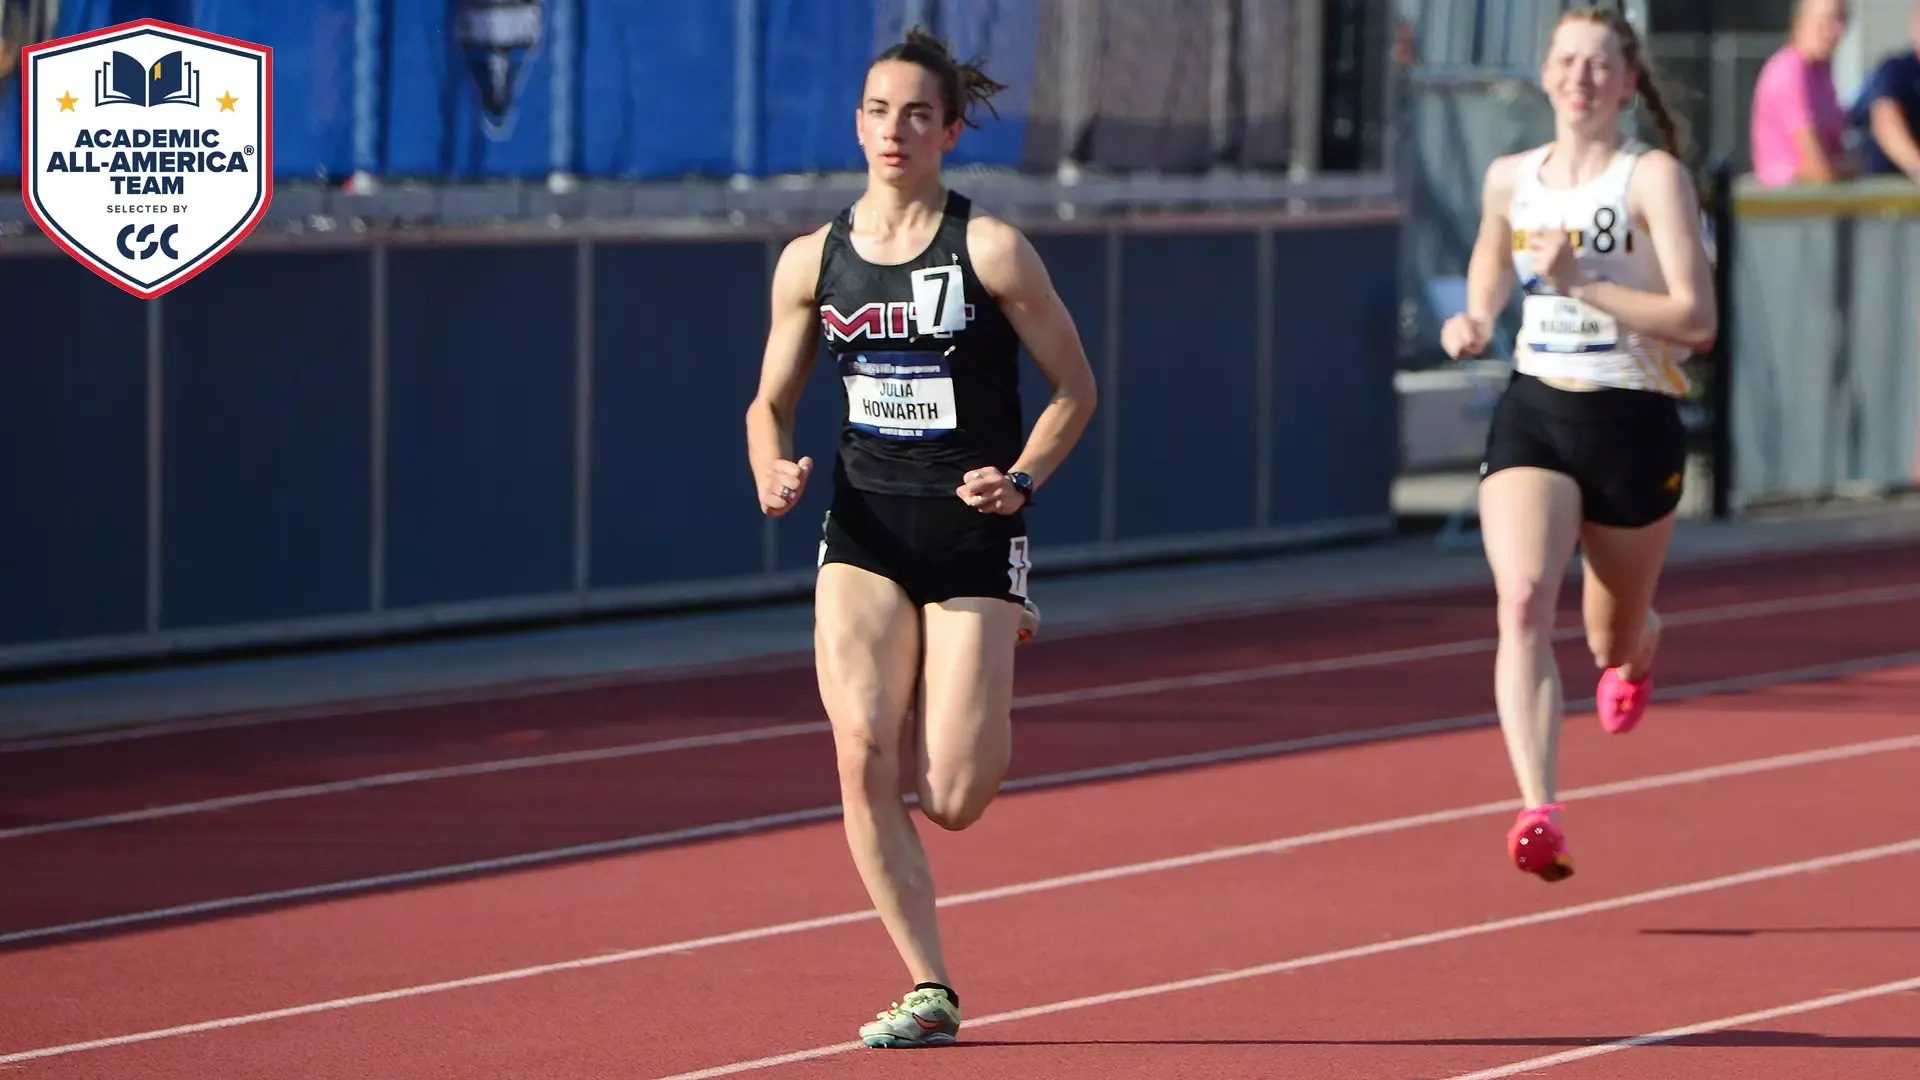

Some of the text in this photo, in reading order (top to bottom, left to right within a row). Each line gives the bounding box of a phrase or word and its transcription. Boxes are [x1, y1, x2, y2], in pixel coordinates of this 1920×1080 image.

[1593, 207, 1616, 253] 8
[923, 272, 950, 329] 7
[879, 382, 914, 398] JULIA
[862, 398, 939, 420] HOWARTH
